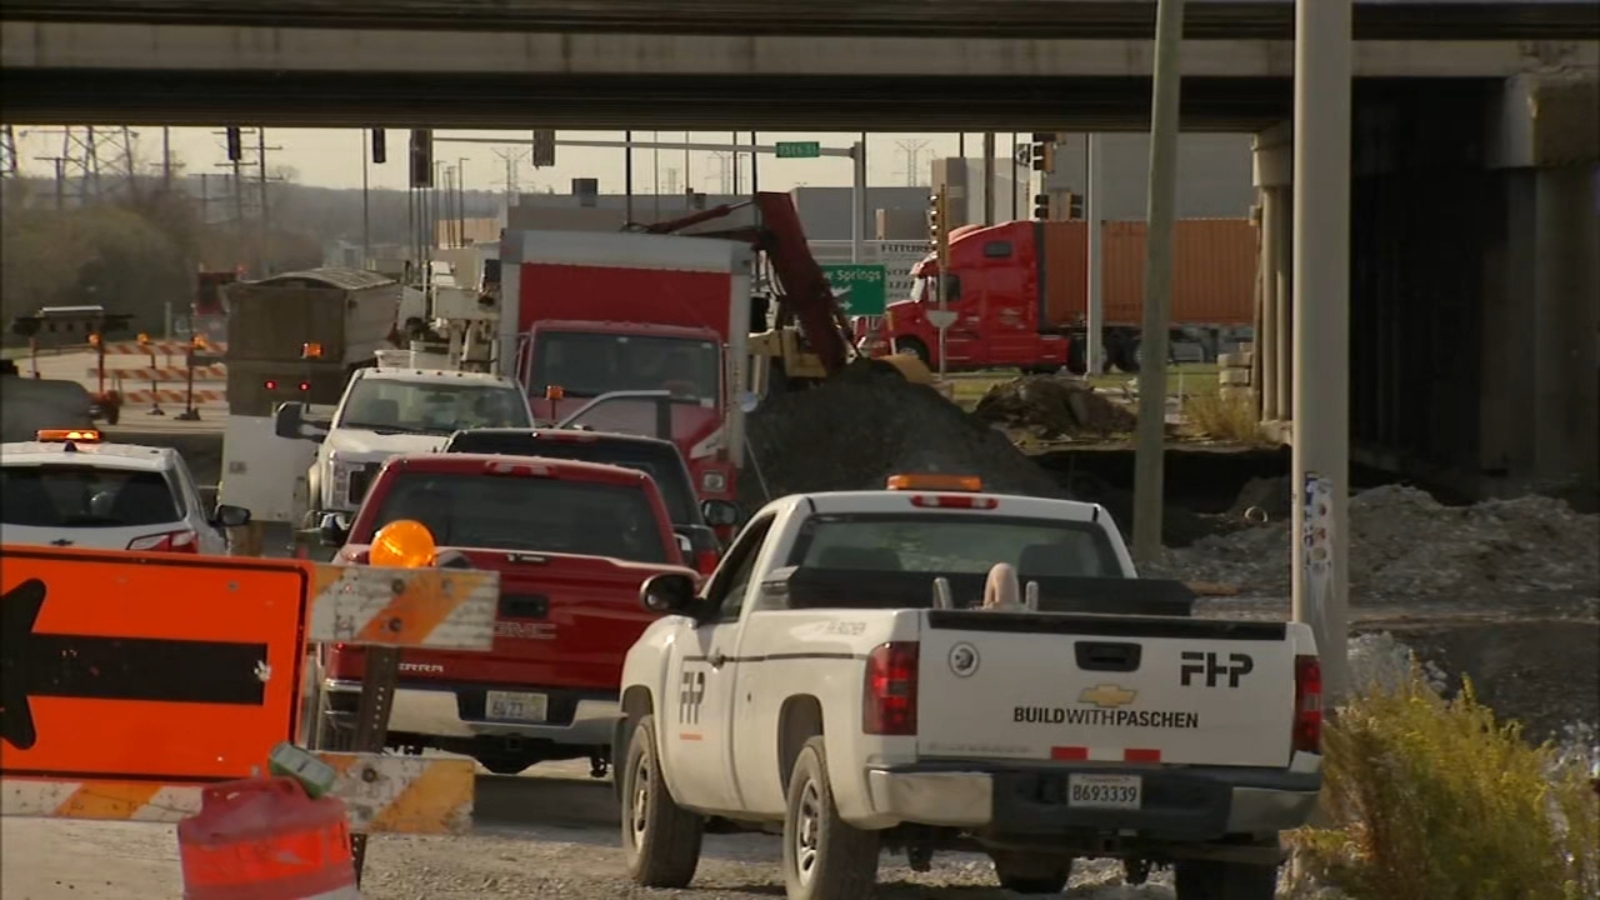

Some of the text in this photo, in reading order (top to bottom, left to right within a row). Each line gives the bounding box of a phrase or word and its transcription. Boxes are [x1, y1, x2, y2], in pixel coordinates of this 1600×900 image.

[837, 270, 881, 282] Springs
[398, 662, 445, 673] ERRA
[1180, 651, 1254, 688] FHP
